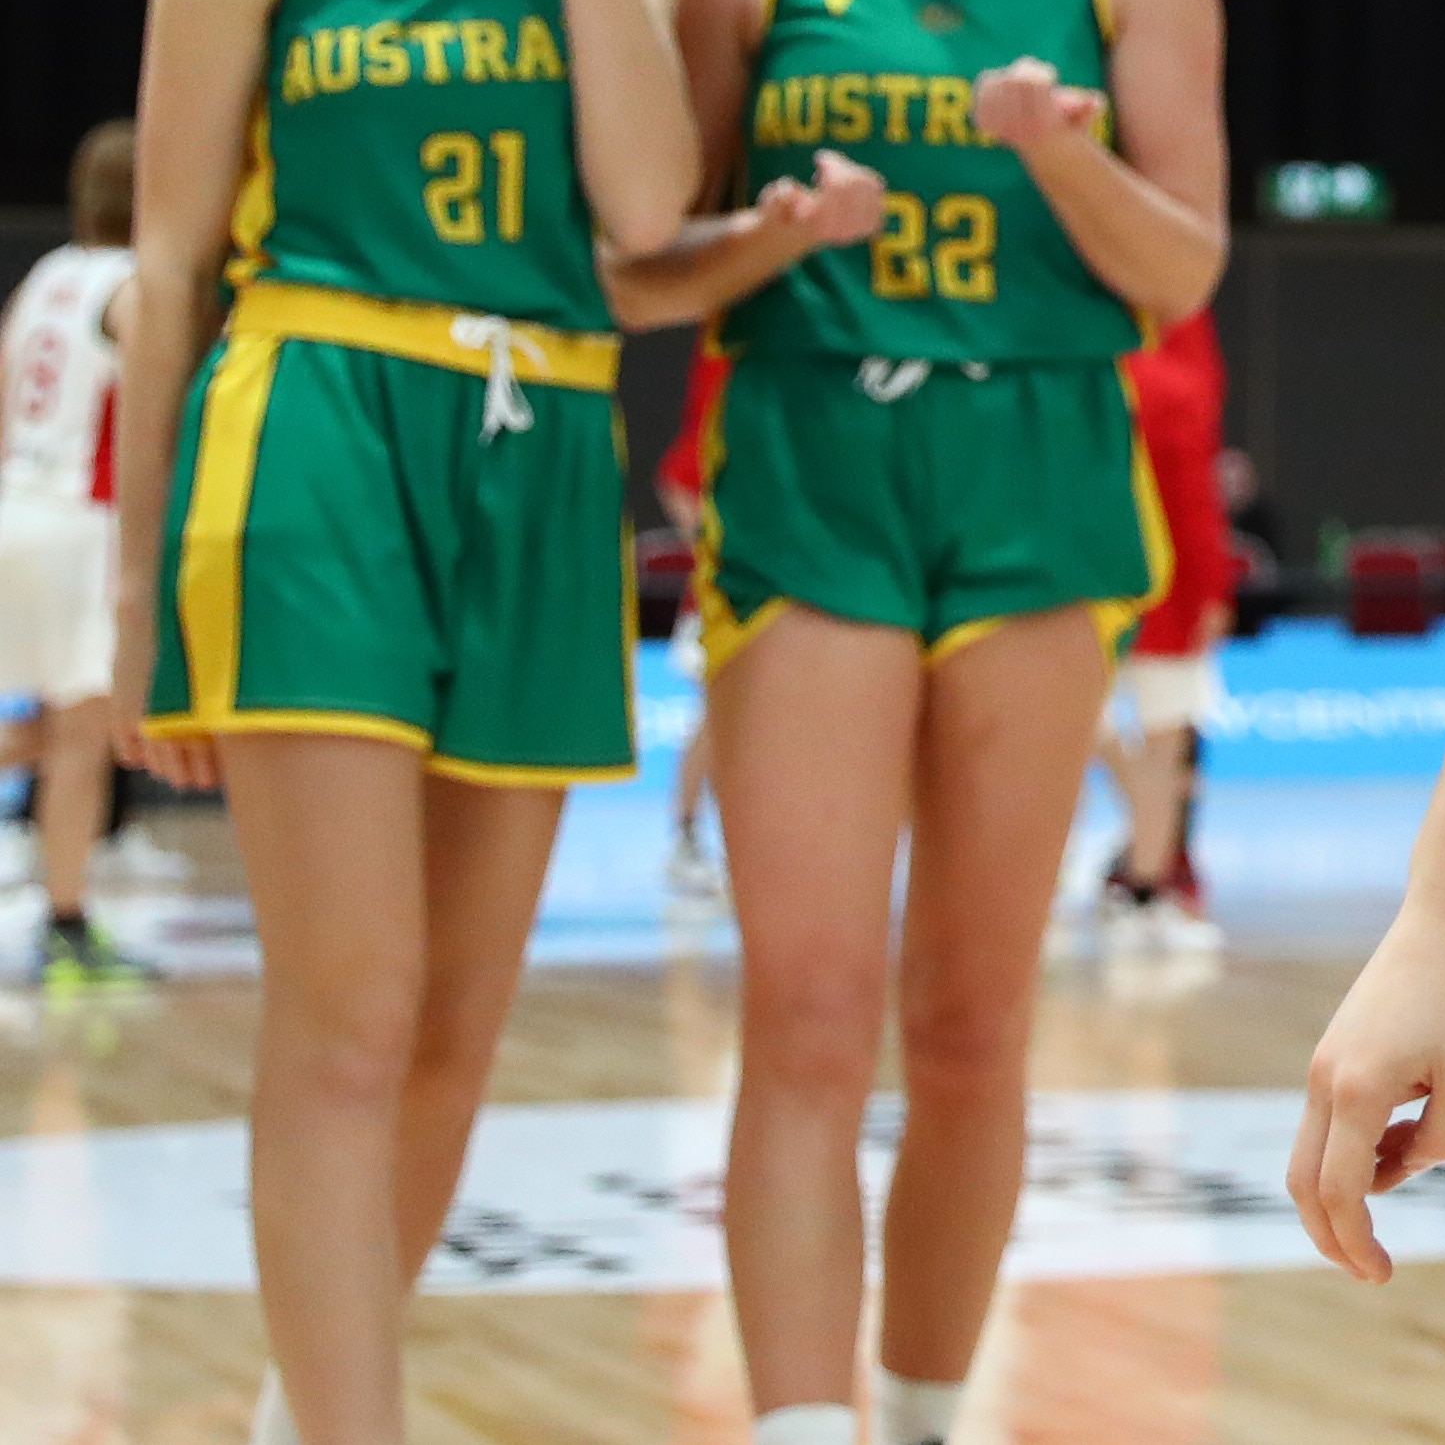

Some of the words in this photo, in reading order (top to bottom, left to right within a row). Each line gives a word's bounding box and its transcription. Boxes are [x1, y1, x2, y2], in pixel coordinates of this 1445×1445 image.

[754, 72, 1000, 148] AUSTR
[419, 130, 527, 244] 21
[870, 190, 998, 304] 22
